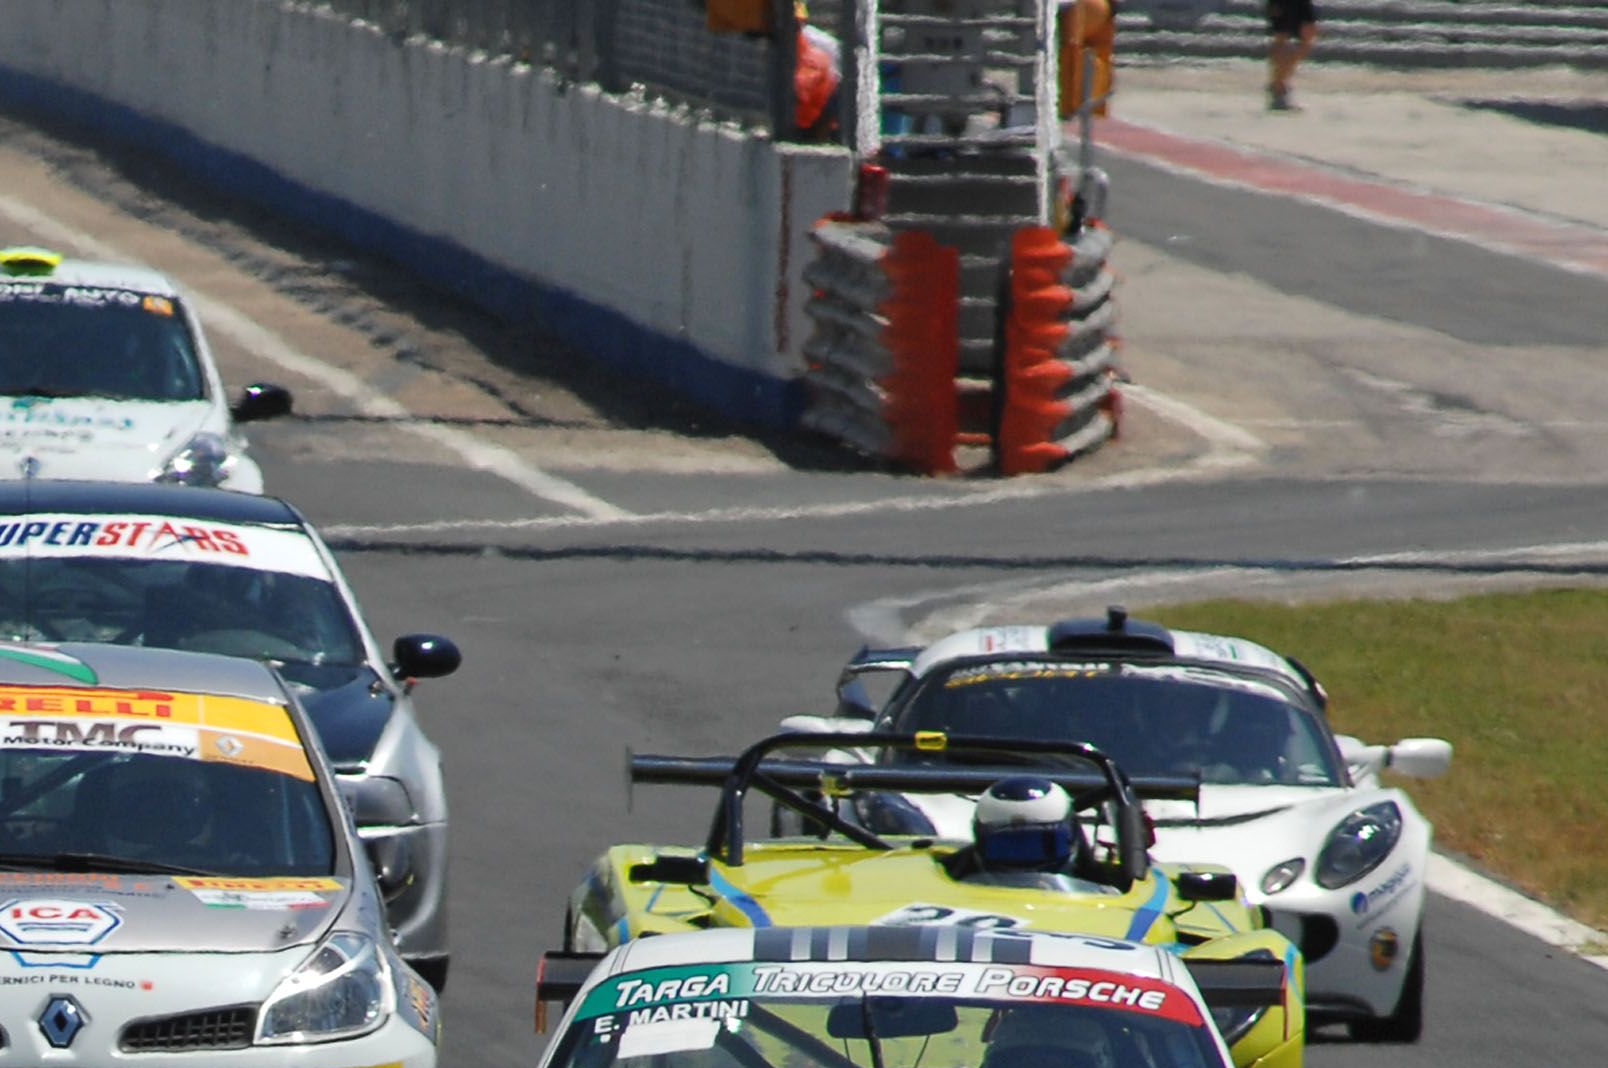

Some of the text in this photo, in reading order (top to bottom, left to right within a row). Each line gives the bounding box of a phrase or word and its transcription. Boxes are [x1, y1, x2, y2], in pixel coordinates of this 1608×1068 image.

[2, 734, 74, 747] Motor
[81, 736, 197, 756] Company
[8, 720, 163, 746] TMC
[10, 906, 102, 920] ICA
[48, 974, 80, 984] PER
[84, 976, 136, 990] LEGNO
[615, 973, 731, 1009] TARGA
[975, 965, 1168, 1012] PORSCHE
[593, 999, 750, 1035] E. MARTINI
